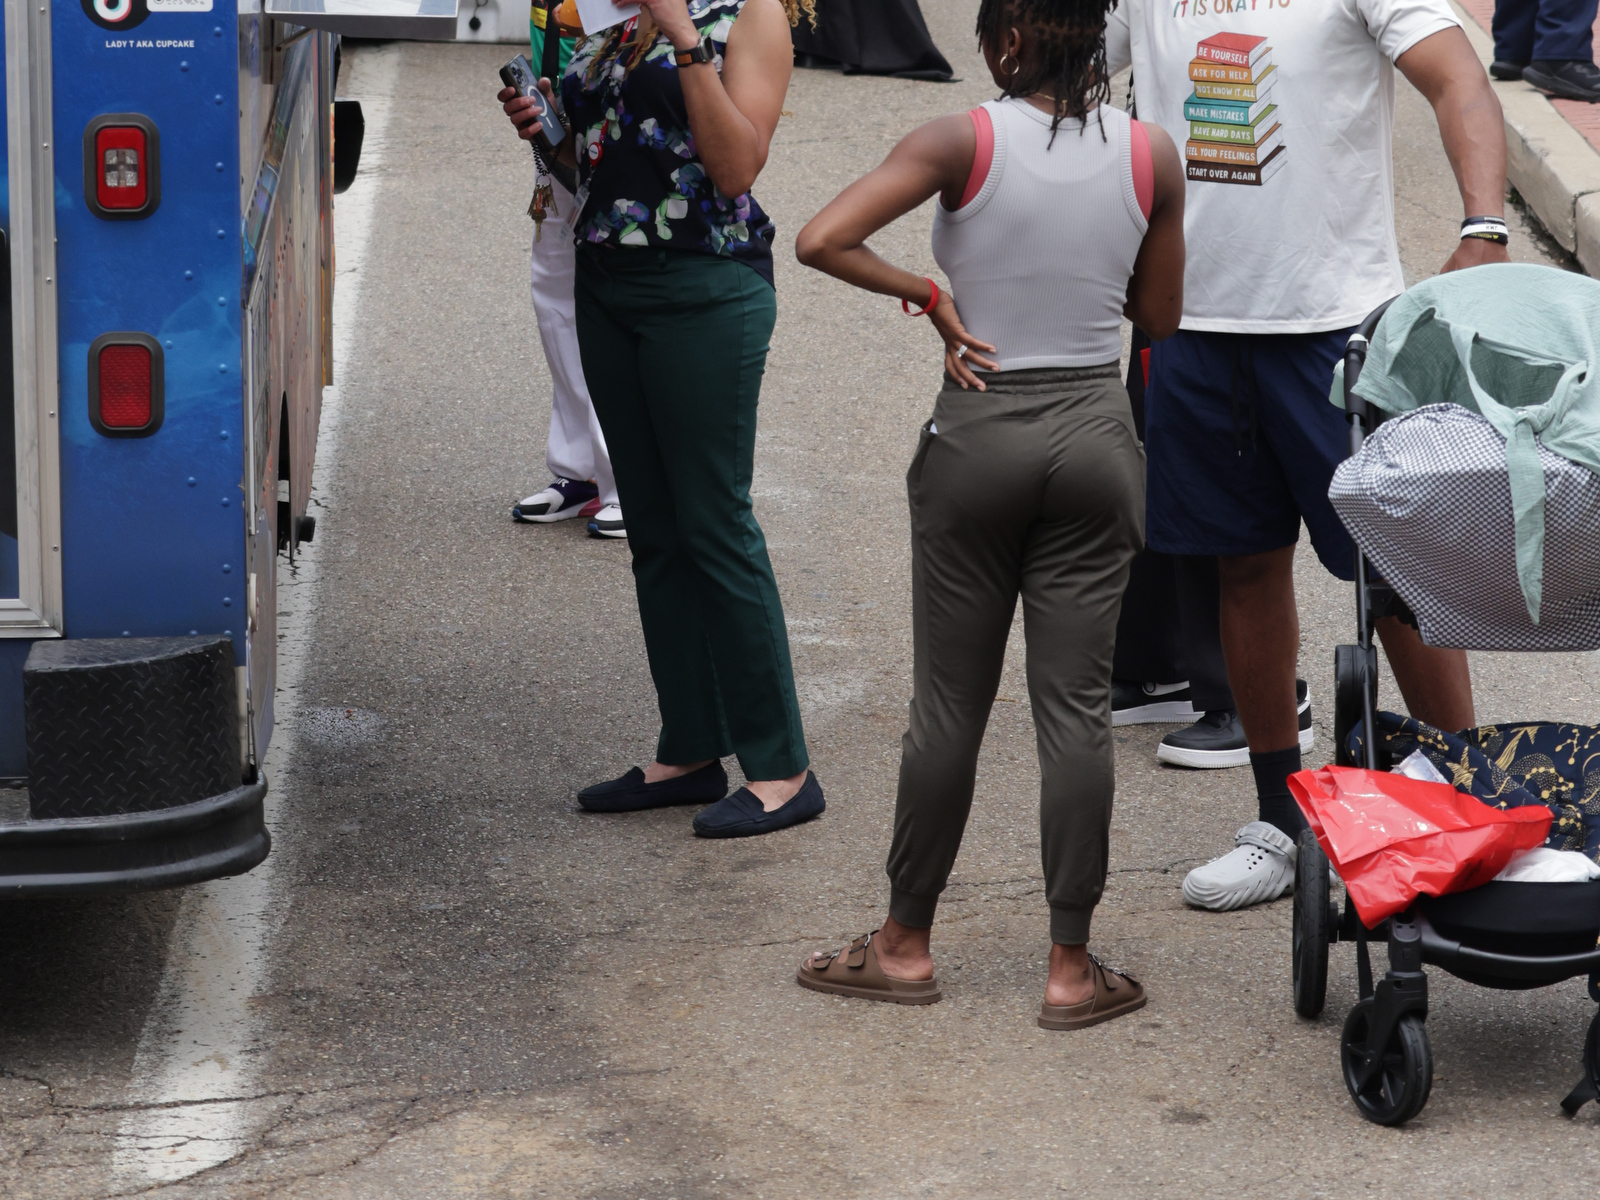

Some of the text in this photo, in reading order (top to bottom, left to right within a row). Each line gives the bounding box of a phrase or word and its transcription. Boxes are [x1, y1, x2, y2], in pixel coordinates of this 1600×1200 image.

[1173, 0, 1189, 18] IT
[105, 40, 195, 48] LADY T AKA CUPCAKE
[1198, 46, 1248, 65] BE YOURSELF
[1192, 68, 1248, 80] ASK FOR HELP
[1196, 84, 1255, 98] NOT KNOW IT ALL
[1188, 107, 1245, 122] MAKE MISTAKES
[1193, 125, 1251, 140] HAVE HARD DAYS
[1186, 146, 1255, 161] FEEL YOUR FEELINGS
[1188, 166, 1256, 181] START OVER AGAIN
